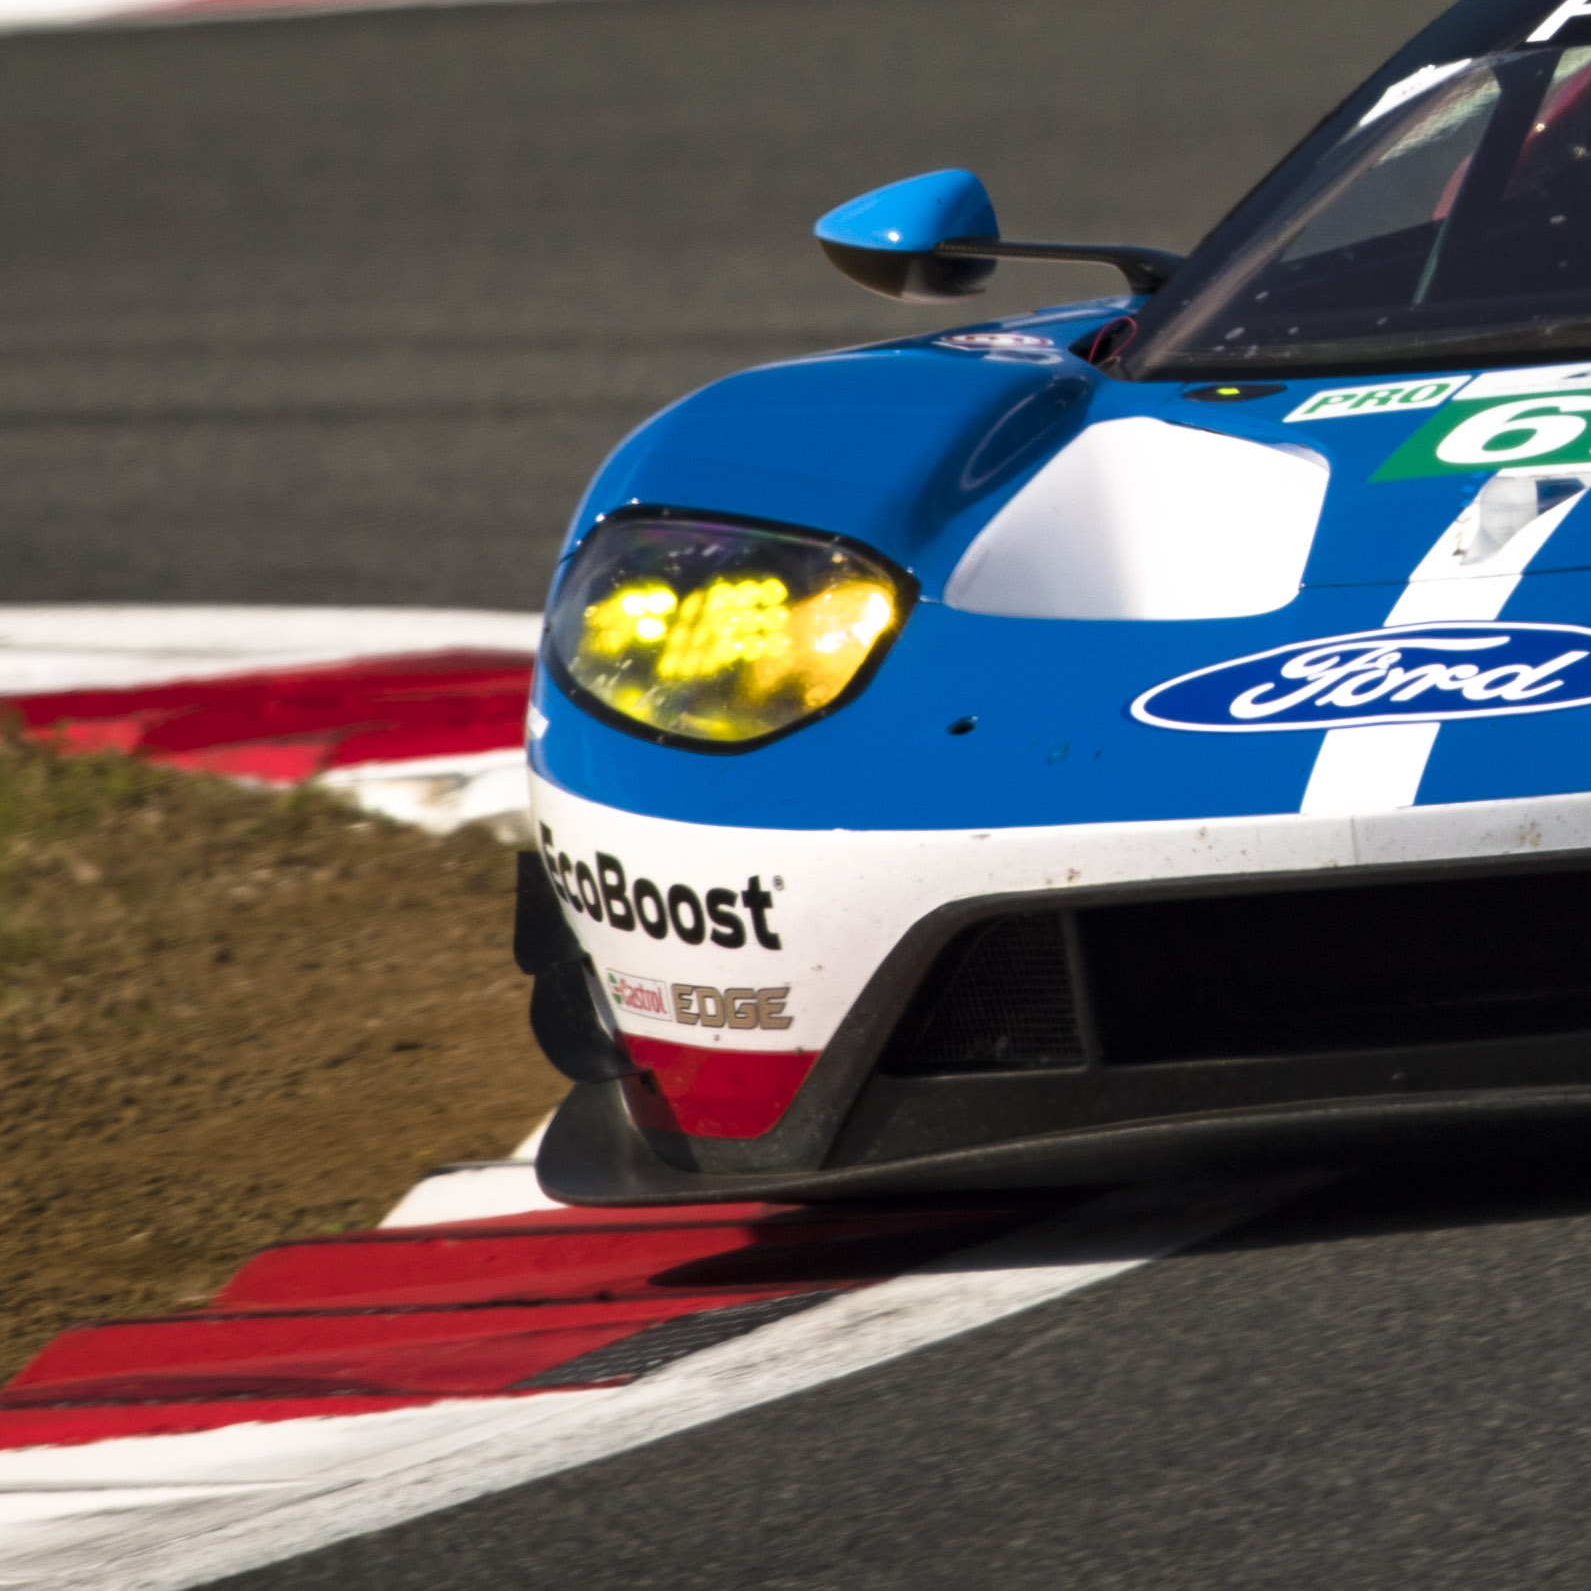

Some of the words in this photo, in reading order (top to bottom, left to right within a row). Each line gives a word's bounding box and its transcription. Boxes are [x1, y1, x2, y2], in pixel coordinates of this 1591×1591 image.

[1303, 382, 1438, 415] PRO
[1228, 635, 1590, 720] Ford
[615, 977, 668, 1016] Castrol
[671, 983, 794, 1030] EDGE
